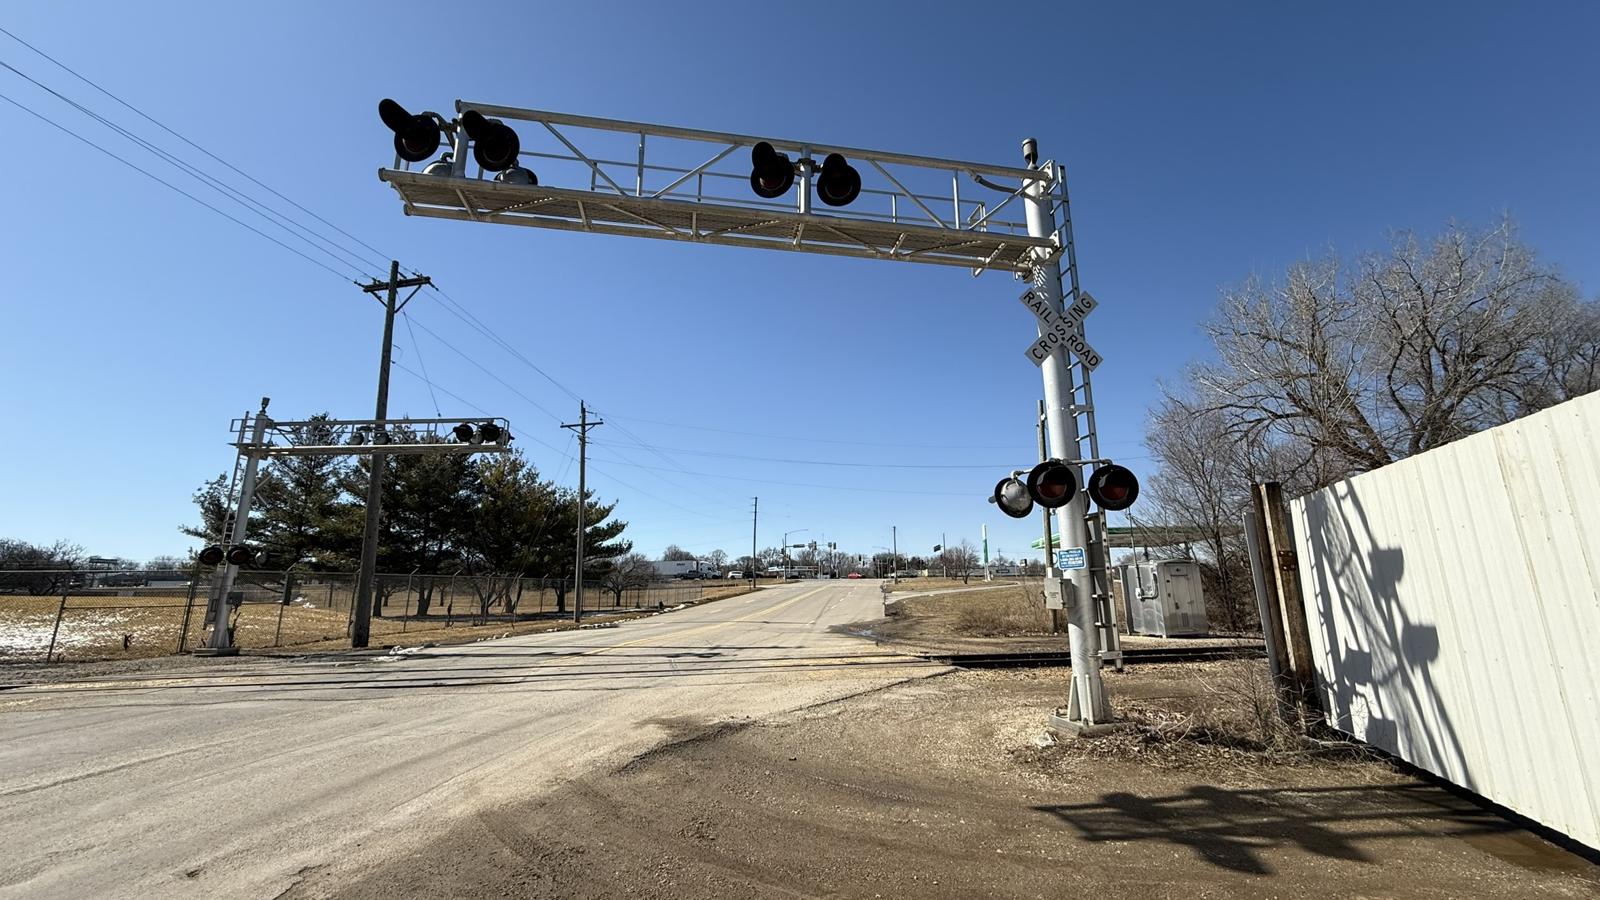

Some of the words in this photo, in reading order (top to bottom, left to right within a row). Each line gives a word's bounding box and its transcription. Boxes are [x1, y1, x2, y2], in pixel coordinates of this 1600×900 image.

[1023, 291, 1052, 324] RAIL
[1066, 334, 1099, 367] ROAD
[1032, 298, 1092, 360] CROSSING
